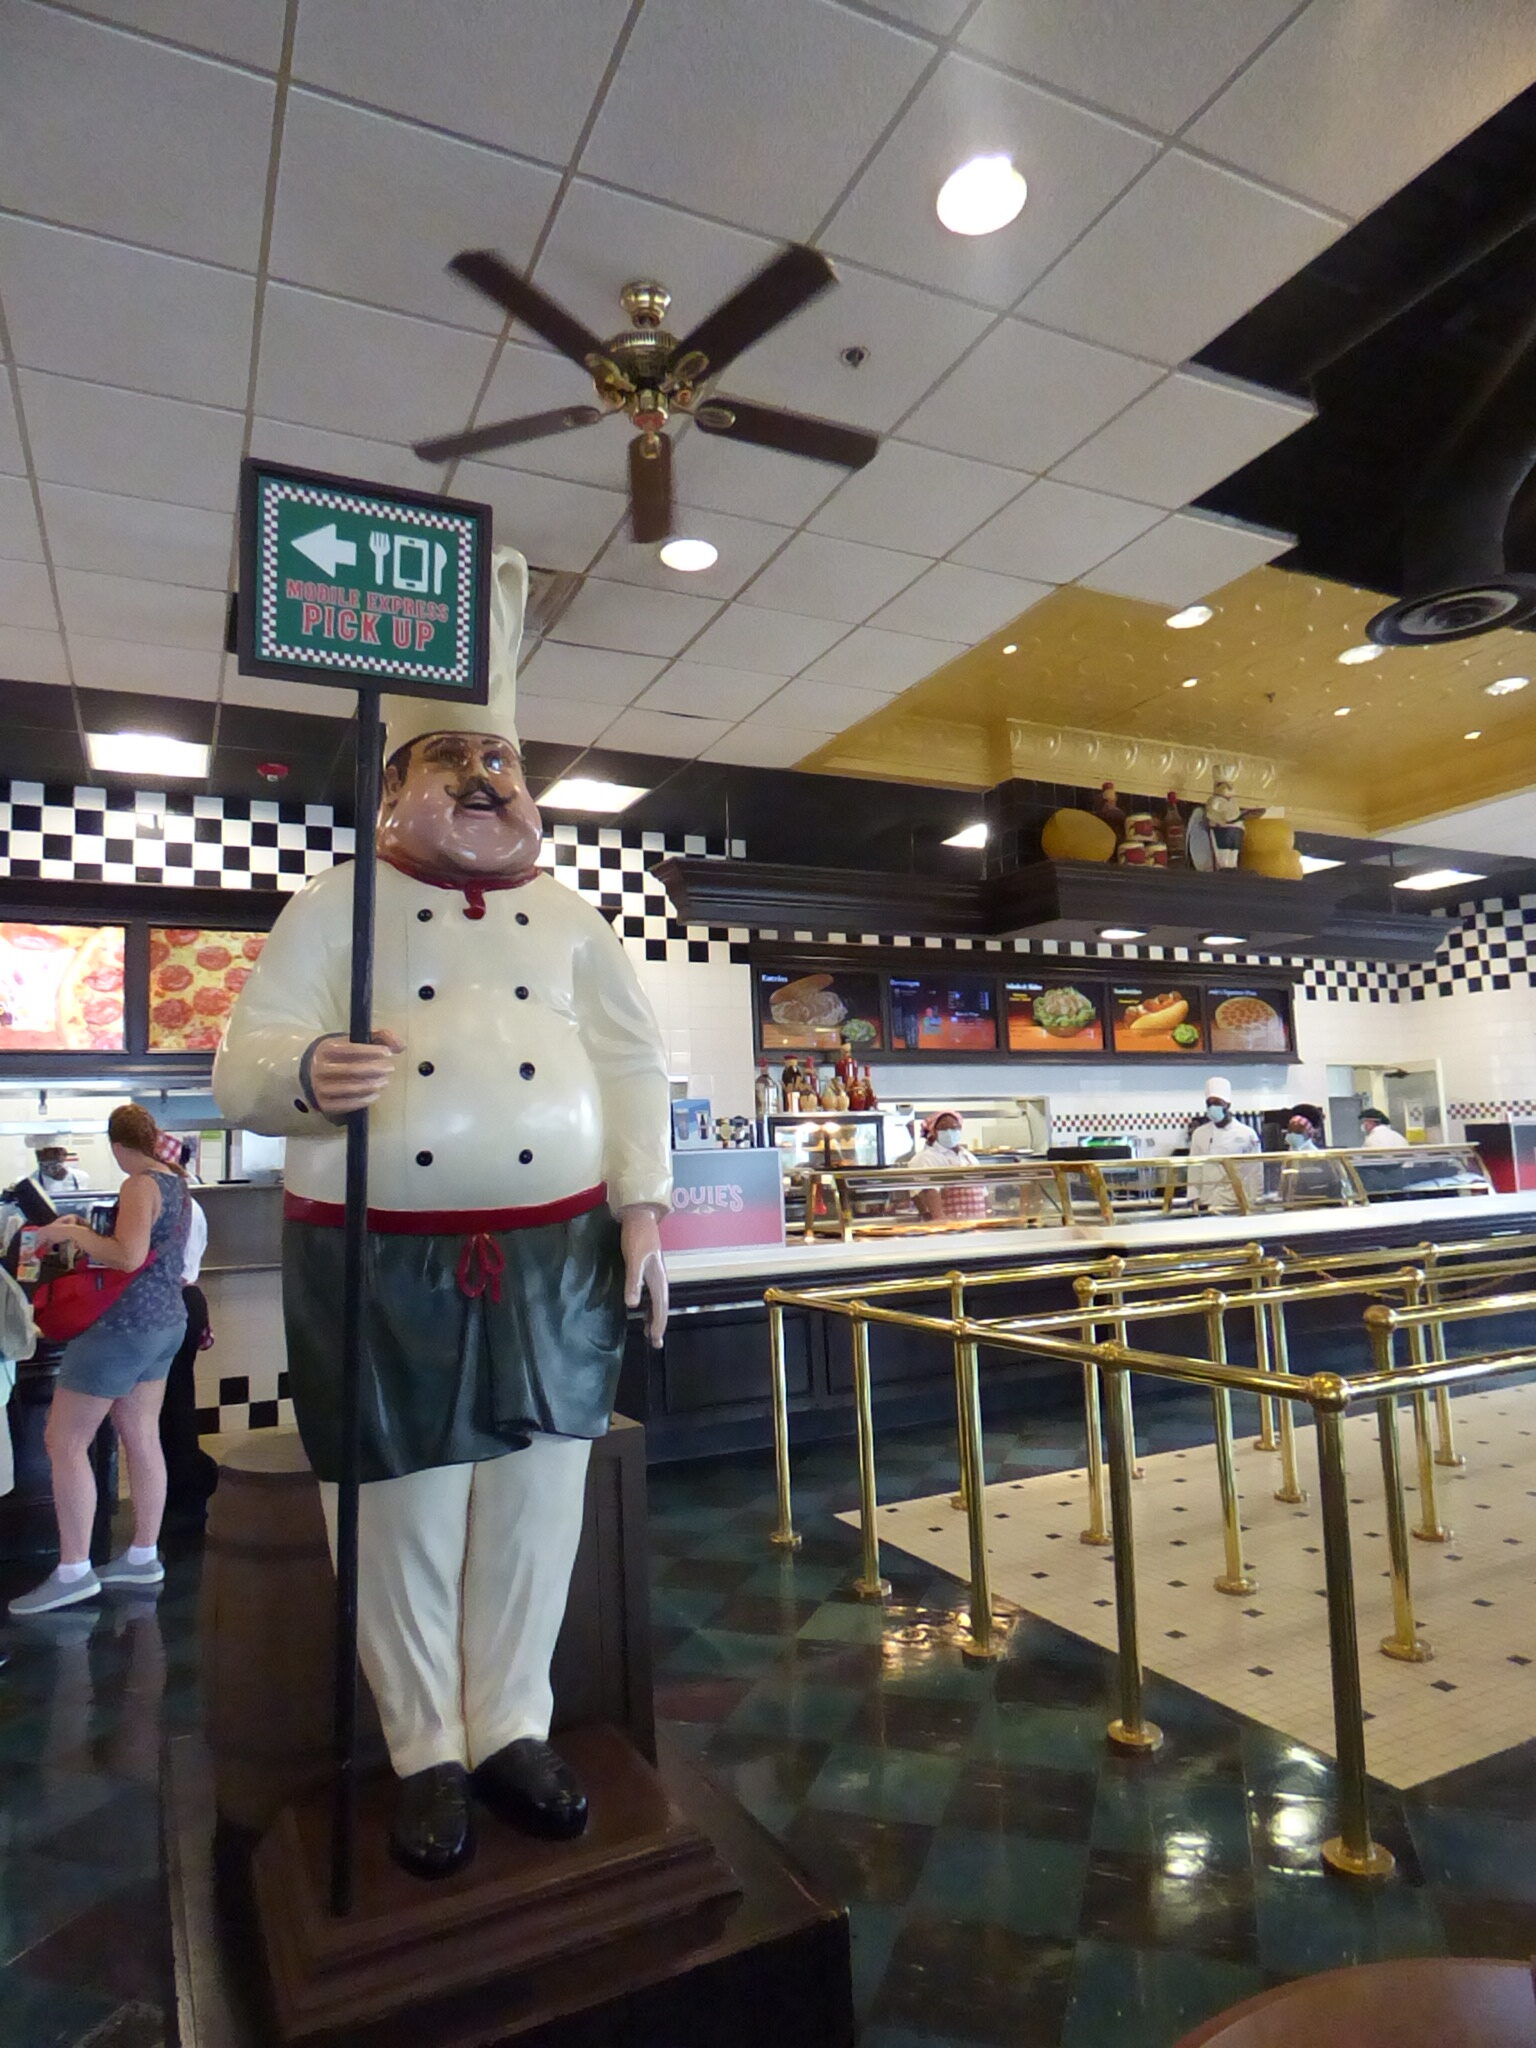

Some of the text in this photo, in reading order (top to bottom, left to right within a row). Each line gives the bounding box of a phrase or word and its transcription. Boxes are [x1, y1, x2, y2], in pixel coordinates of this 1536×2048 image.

[286, 579, 449, 623] MOBILE EXPRESS
[302, 603, 435, 651] PICK UP
